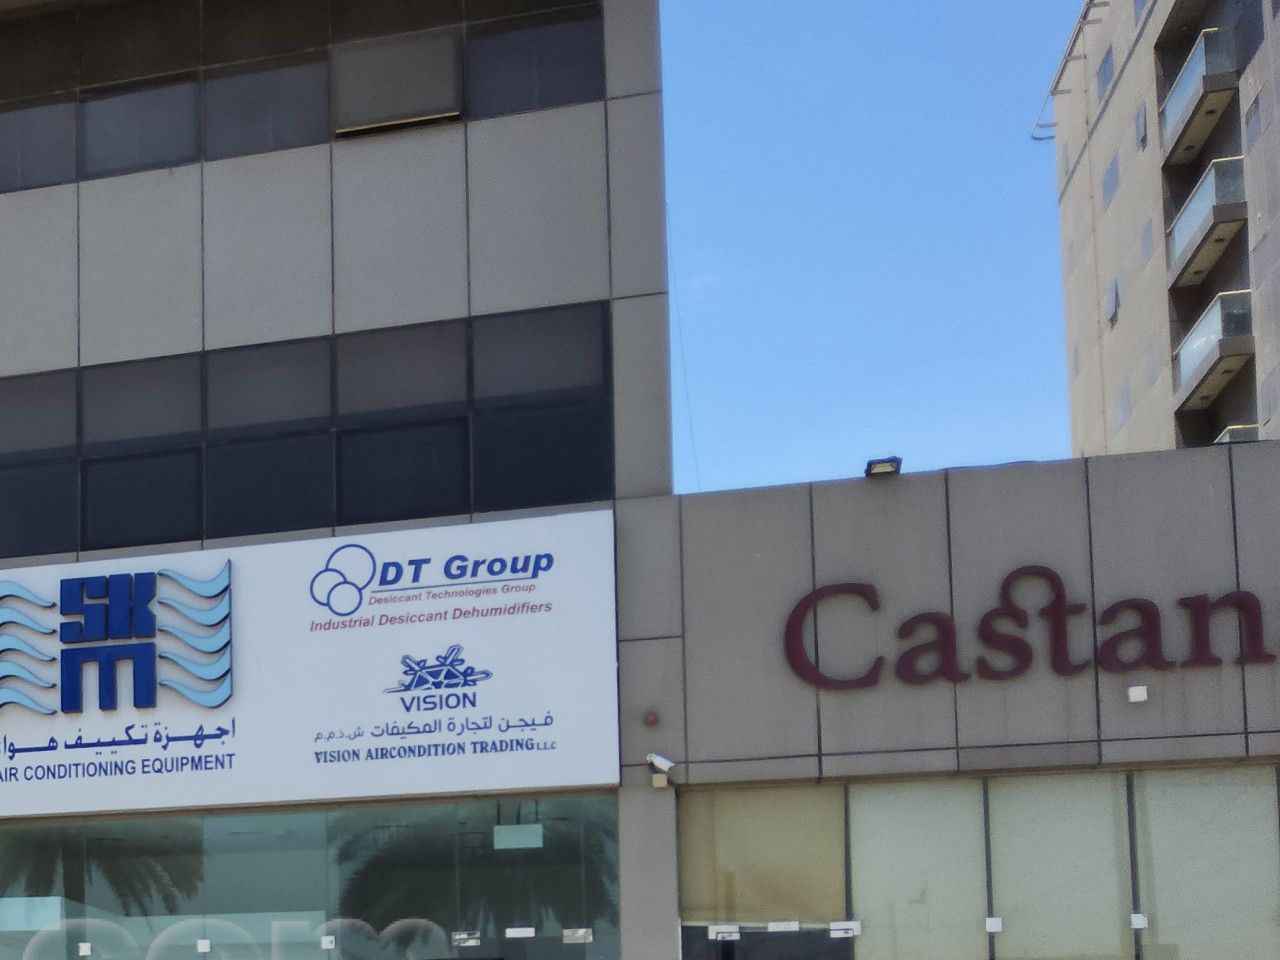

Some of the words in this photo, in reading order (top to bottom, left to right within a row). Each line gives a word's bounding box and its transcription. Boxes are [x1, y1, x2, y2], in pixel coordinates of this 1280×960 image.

[379, 558, 431, 587] DT
[444, 553, 554, 579] Group
[369, 592, 422, 606] Desiccant
[426, 586, 498, 602] Technologies
[501, 582, 537, 595] Group
[310, 615, 374, 632] Industrial
[378, 609, 448, 626] Desiccant
[451, 601, 553, 620] Dehumidifiers
[400, 692, 477, 713] VISION
[64, 723, 148, 756] تكييف
[369, 718, 442, 739] المكيفات
[447, 715, 493, 737] لتجارة
[314, 749, 361, 764] VISION
[365, 741, 466, 762] AIRCONDITION
[471, 737, 536, 755] TRADING
[23, 759, 137, 781] CONDITIONING
[141, 753, 236, 775] EQUIPMENT
